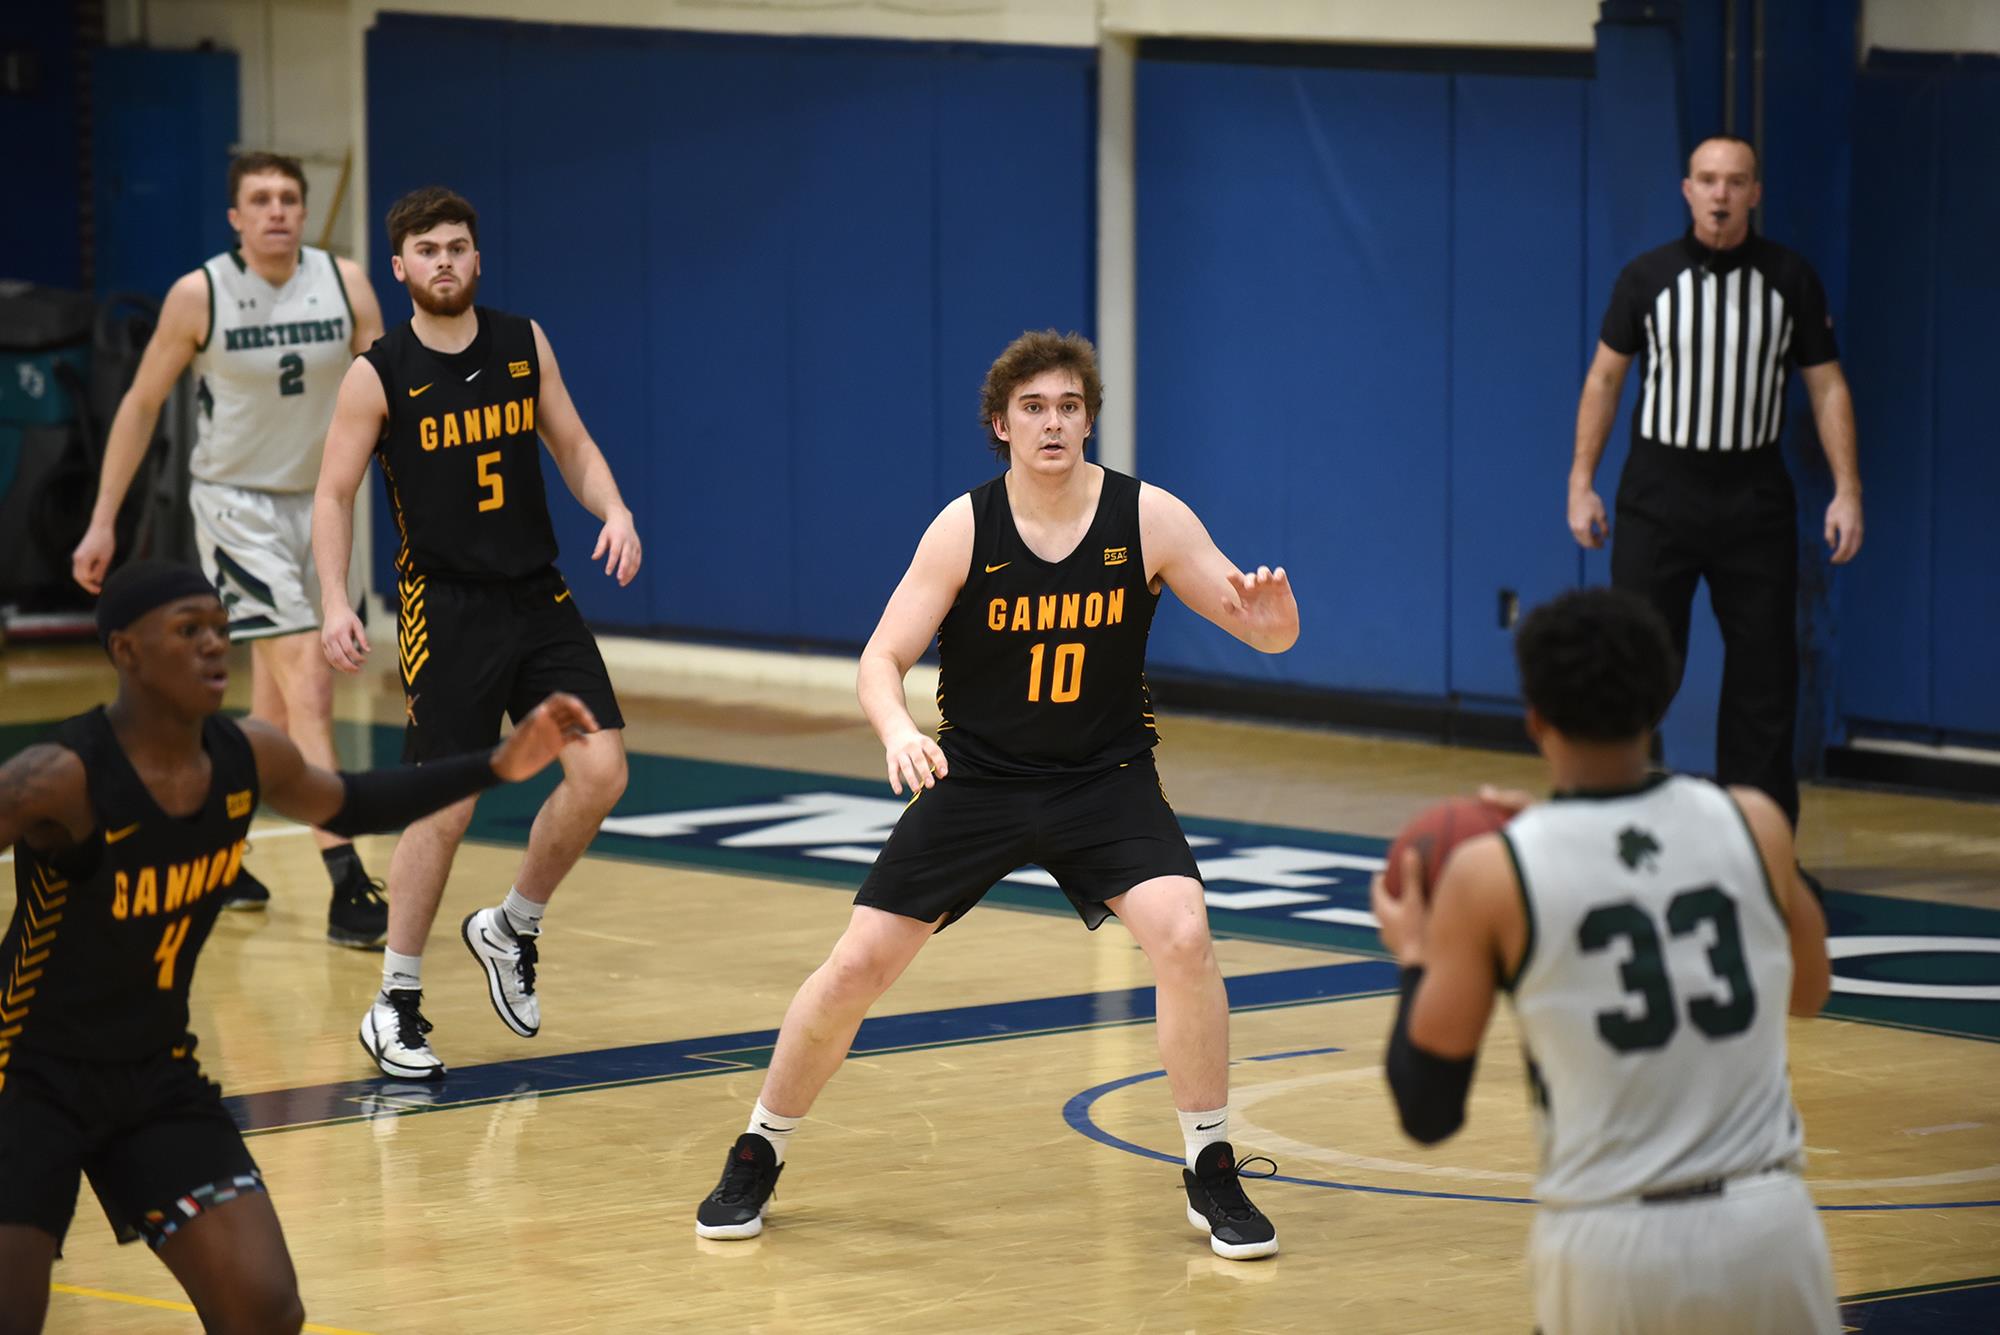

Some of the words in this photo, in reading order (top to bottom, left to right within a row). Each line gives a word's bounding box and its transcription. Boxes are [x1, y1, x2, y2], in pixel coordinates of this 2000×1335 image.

[279, 352, 304, 396] 2
[419, 397, 535, 451] GANNON
[477, 451, 505, 512] 5
[1103, 550, 1128, 562] PSAC
[988, 588, 1125, 631] GANNON
[1028, 643, 1086, 703] 10
[112, 838, 246, 920] GANNON
[154, 914, 192, 989] 4
[1577, 882, 1758, 1055] 33
